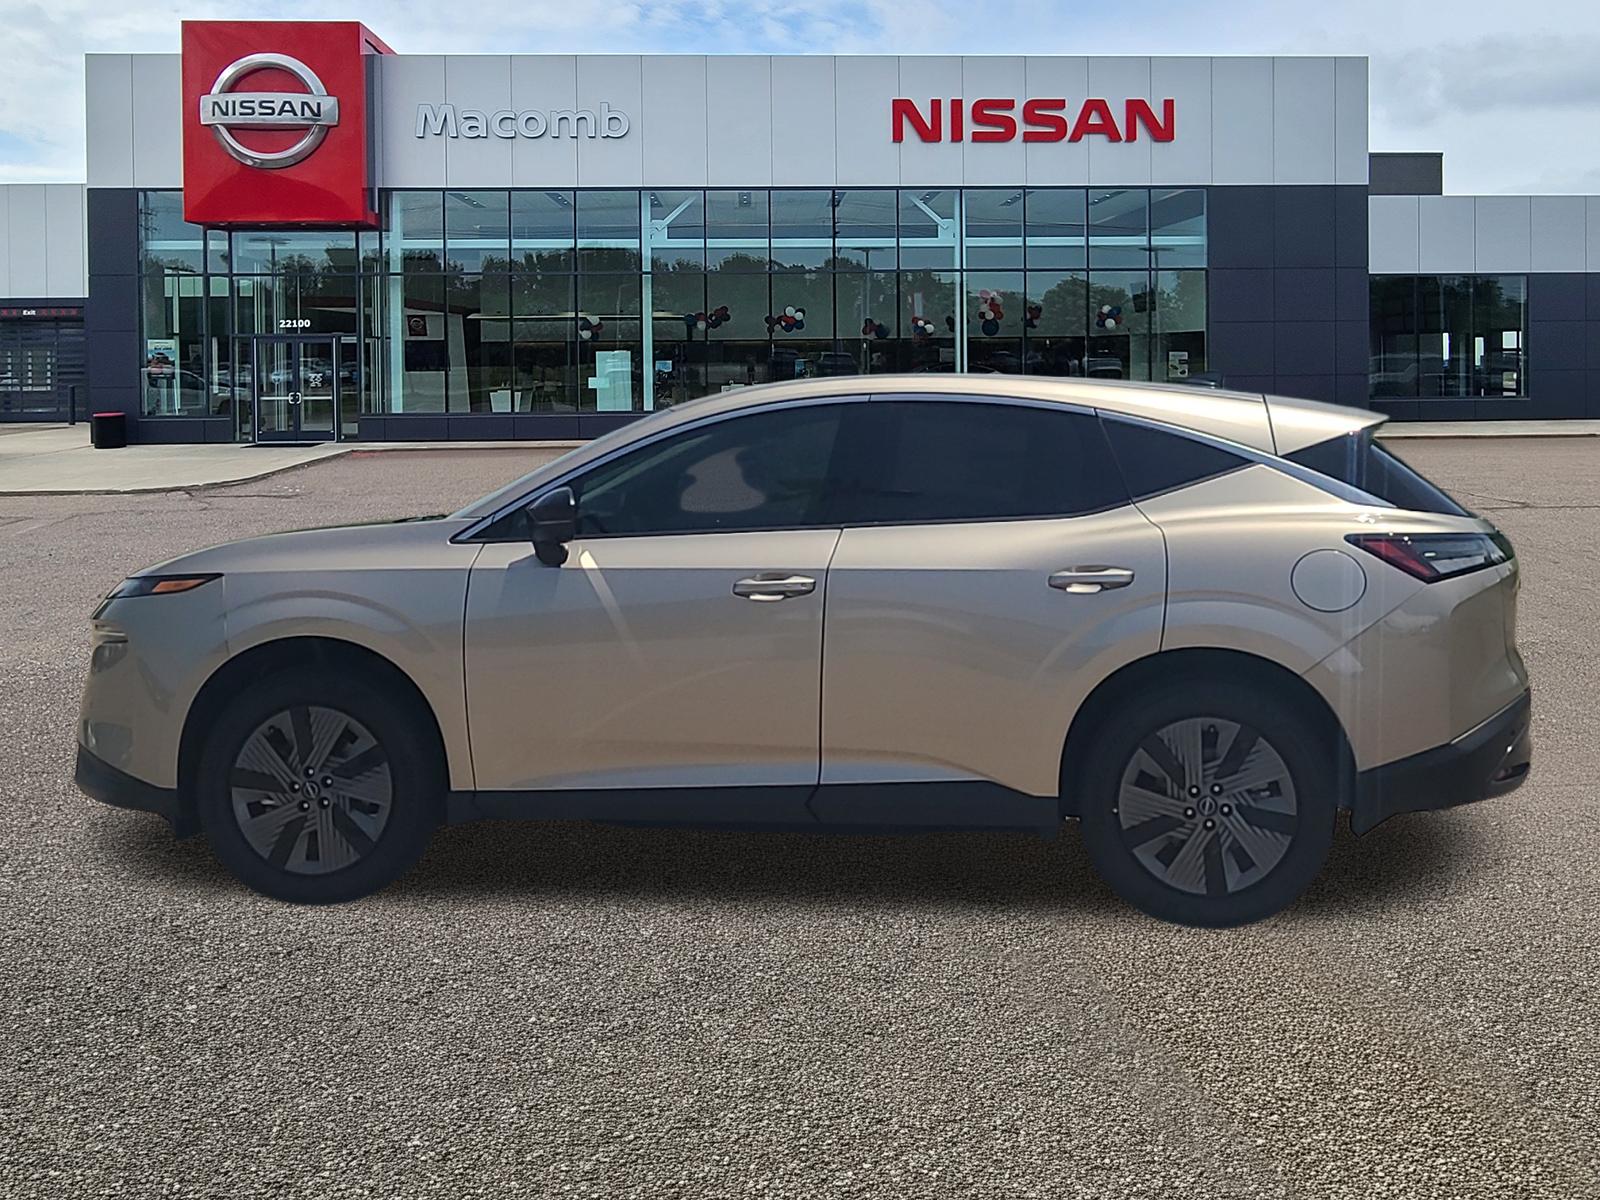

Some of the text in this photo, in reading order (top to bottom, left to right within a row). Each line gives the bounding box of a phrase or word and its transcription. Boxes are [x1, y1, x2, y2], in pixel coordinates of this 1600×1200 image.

[212, 100, 322, 117] NISSAN
[415, 102, 630, 139] Macomb
[892, 98, 1175, 142] NISSAN
[279, 319, 311, 328] 22100
